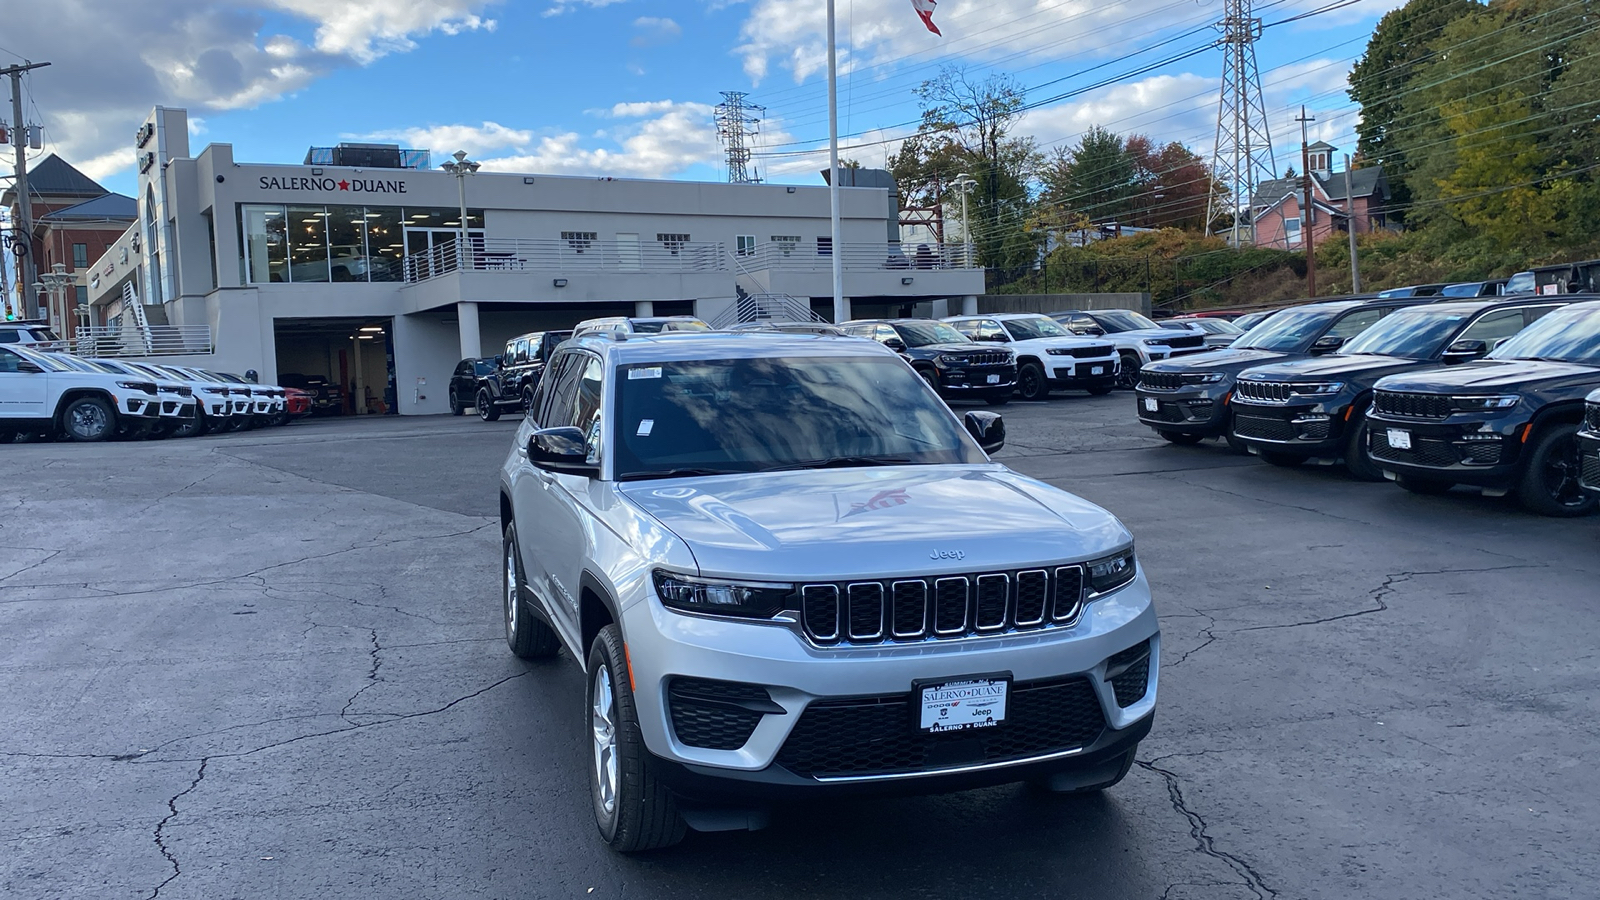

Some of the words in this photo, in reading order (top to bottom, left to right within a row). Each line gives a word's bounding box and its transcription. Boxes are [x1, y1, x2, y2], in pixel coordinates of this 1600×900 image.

[259, 176, 336, 192] SALERNO
[352, 179, 407, 194] DUANE
[929, 548, 966, 561] Jeep
[923, 689, 967, 702] SALERNO
[971, 685, 1004, 697] DUANE
[972, 708, 992, 717] Jeep
[929, 723, 963, 733] SALERNO
[973, 720, 998, 729] DUANE
